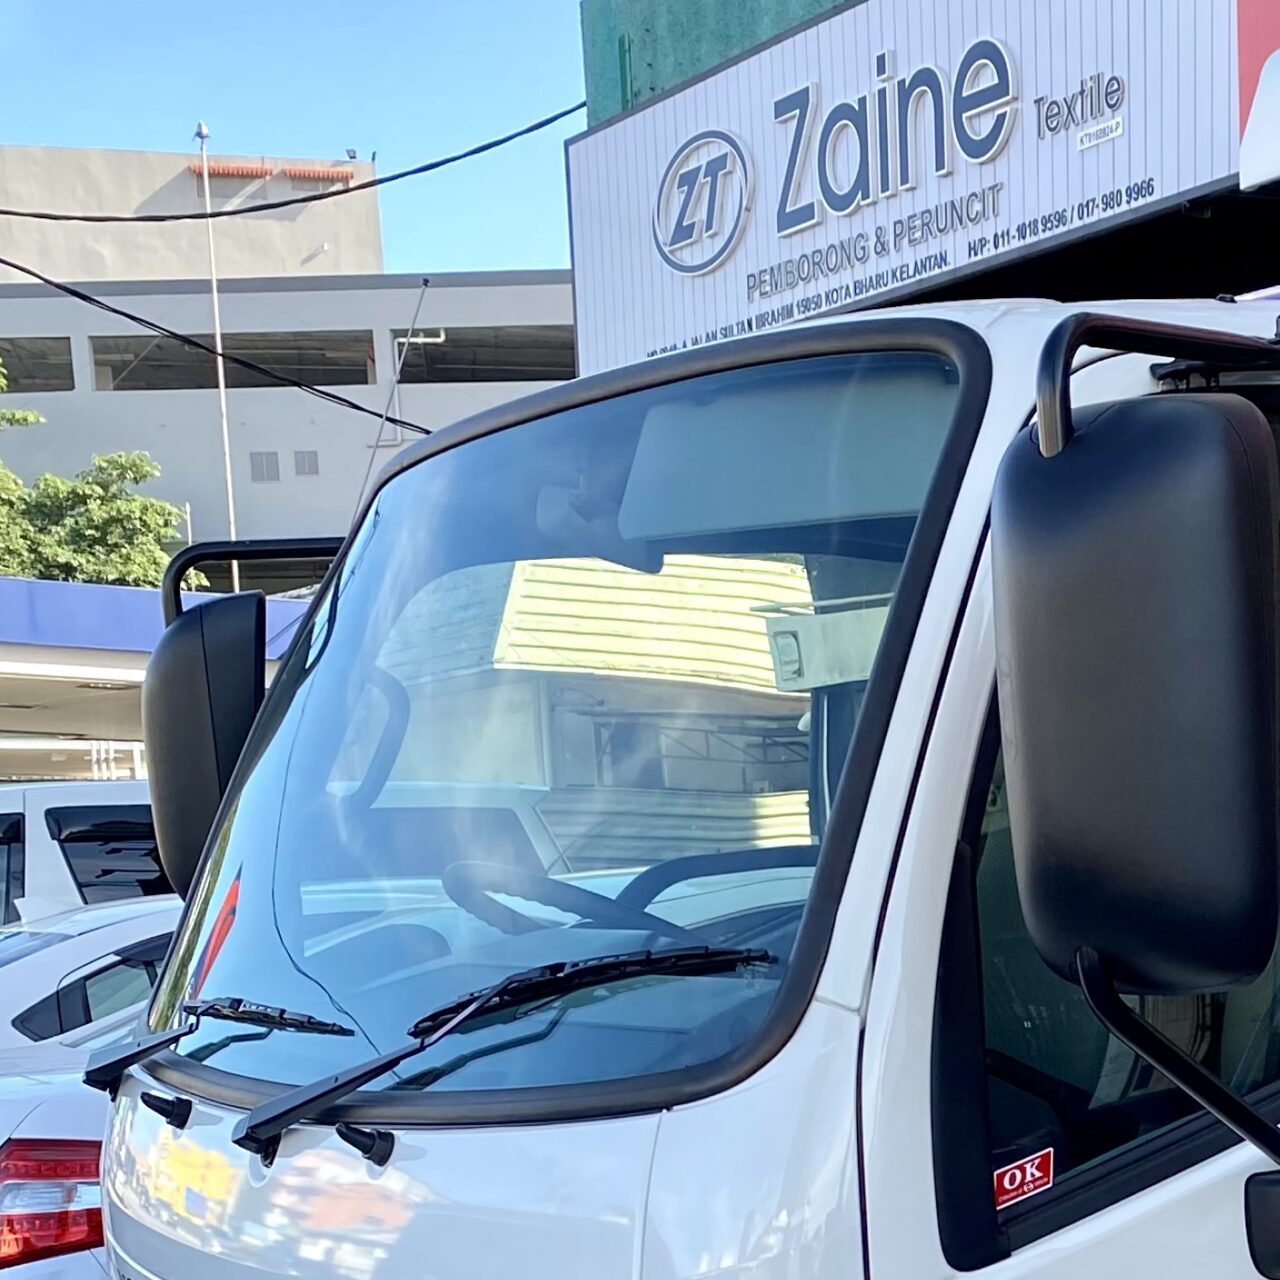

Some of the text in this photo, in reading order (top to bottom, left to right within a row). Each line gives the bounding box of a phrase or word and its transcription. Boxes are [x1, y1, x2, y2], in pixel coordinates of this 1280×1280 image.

[773, 37, 1018, 237] Zaine
[1033, 72, 1124, 140] Textile
[746, 182, 1003, 303] PEMBORONG & PERUNCIT
[968, 236, 991, 259] H/P:
[993, 218, 1039, 250] 011-1018
[1040, 208, 1068, 234] 9596
[1125, 177, 1155, 204] 9966
[719, 317, 753, 340] SULTAN
[755, 303, 794, 330] IBRAHIM
[795, 291, 823, 316] 15050
[824, 284, 852, 305] KOTA
[854, 271, 890, 297] BHARU
[1003, 1157, 1044, 1190] OK
